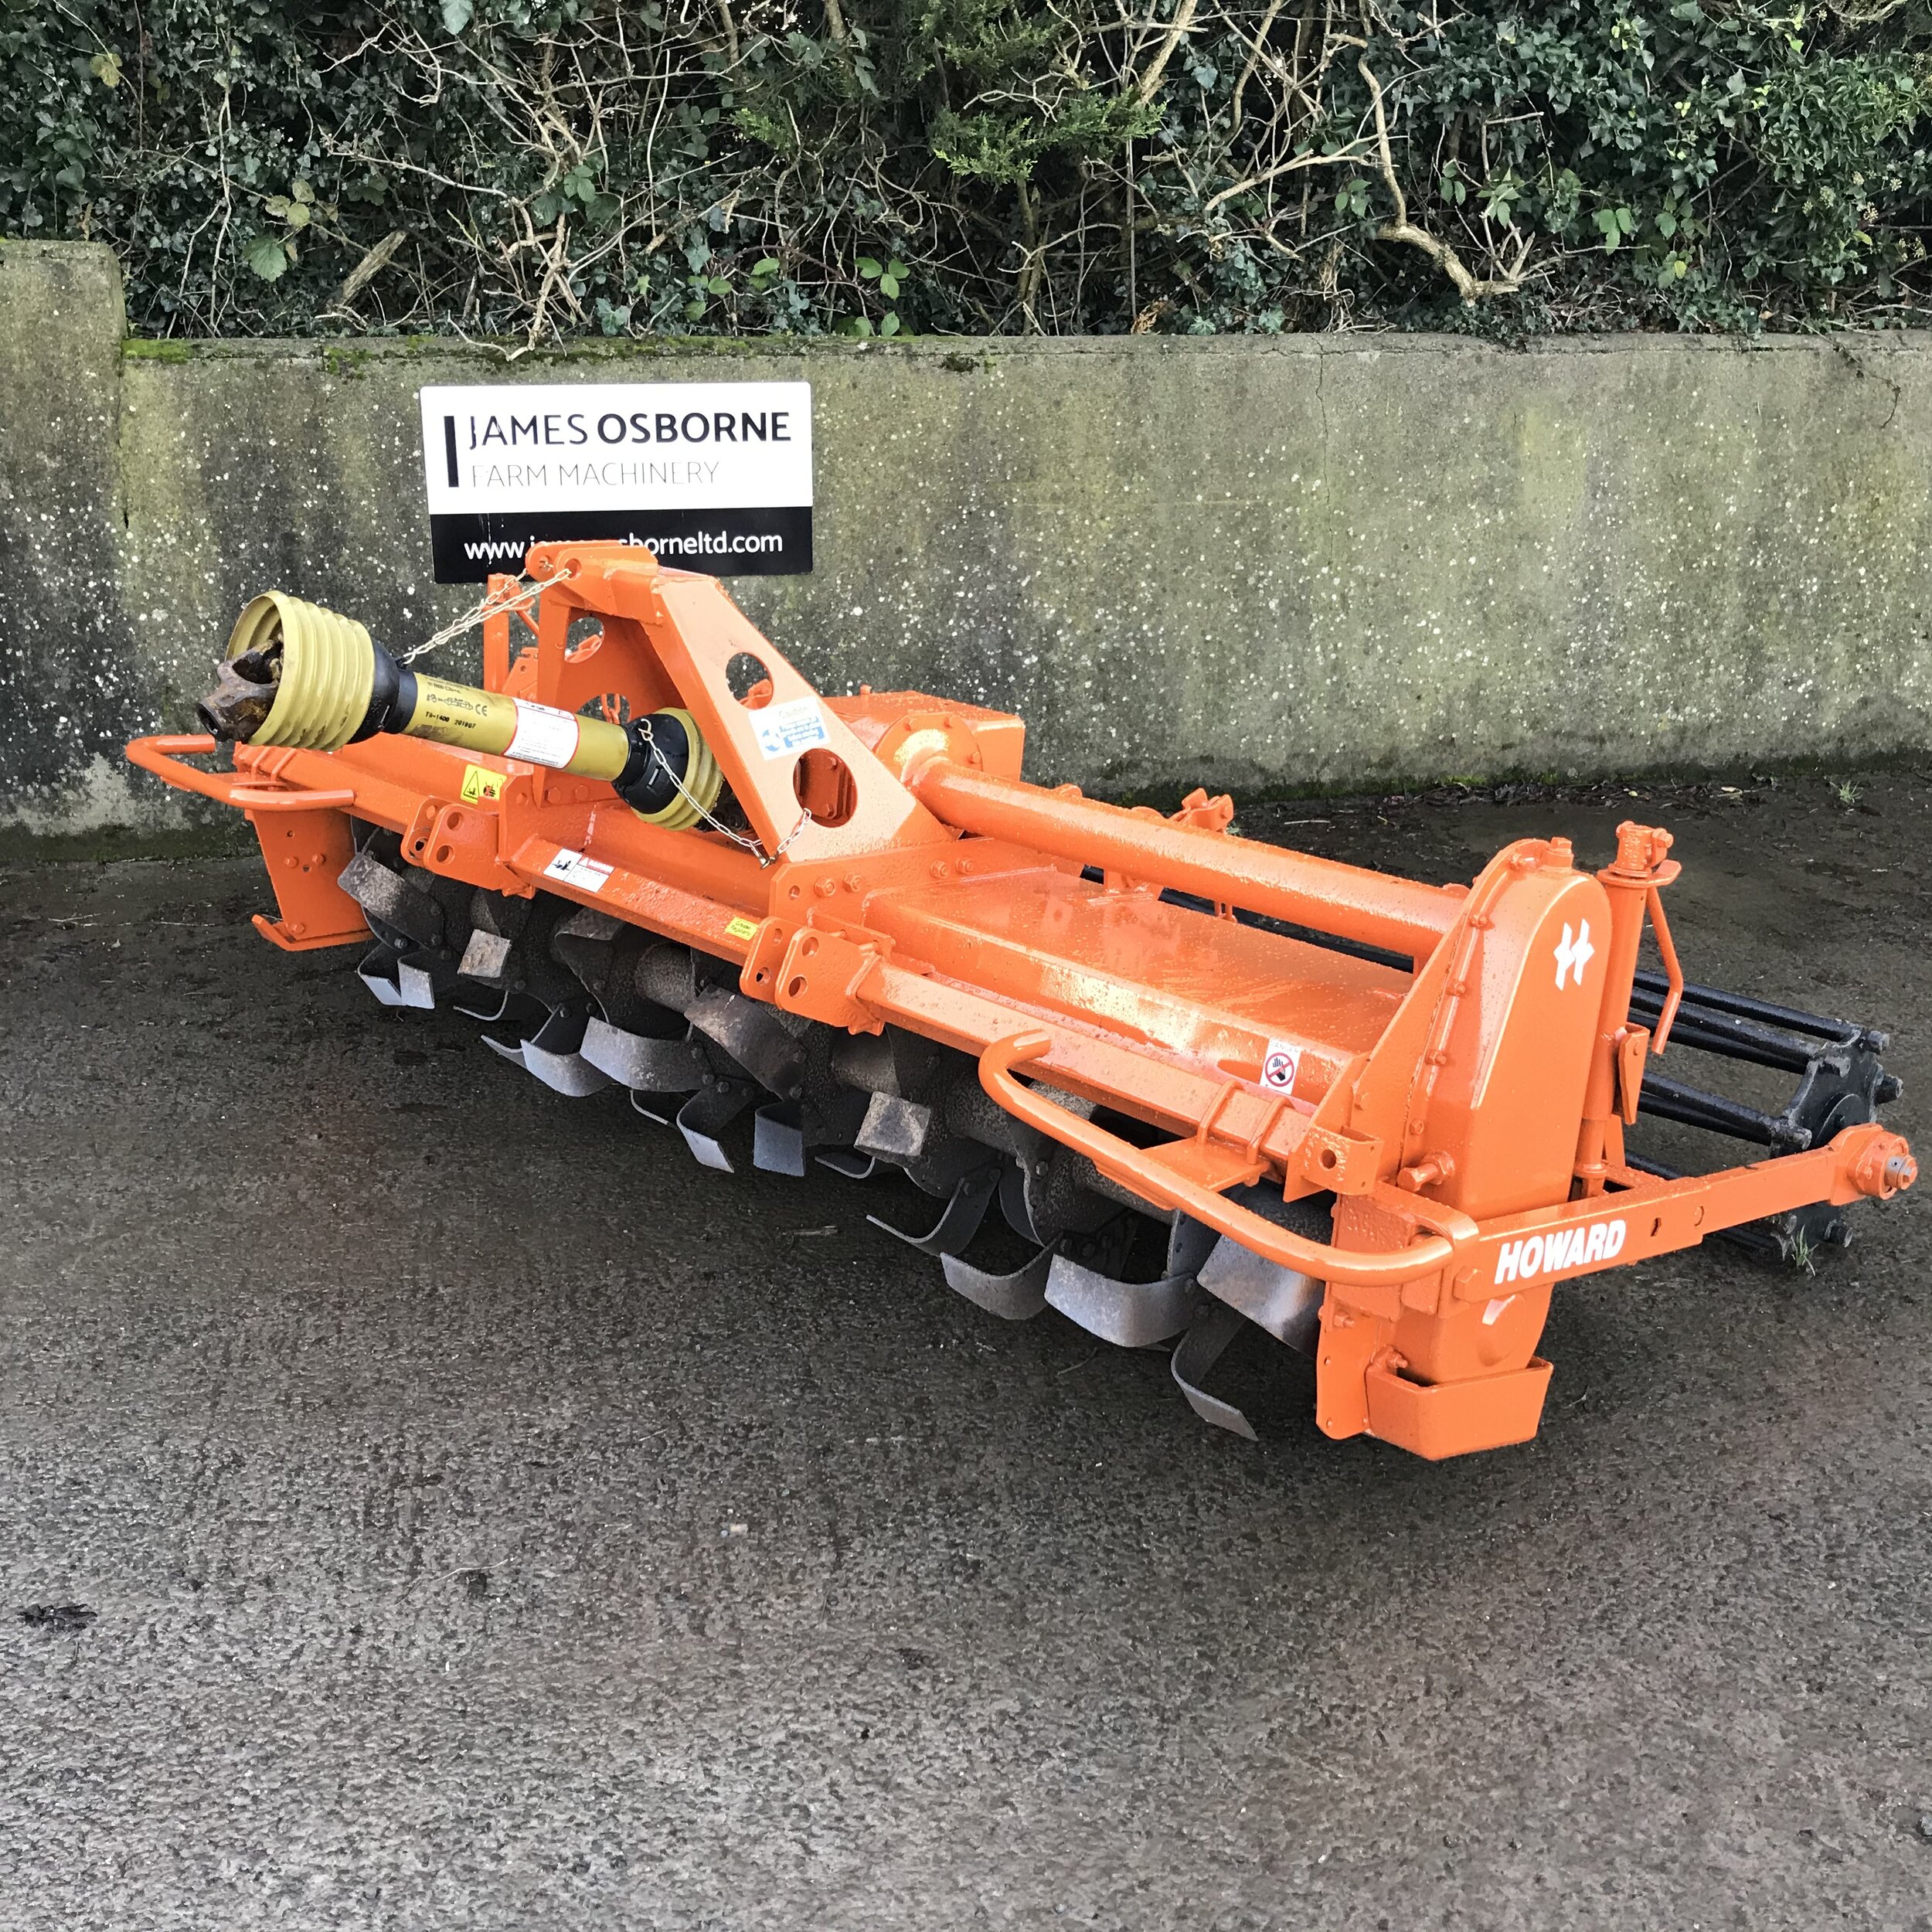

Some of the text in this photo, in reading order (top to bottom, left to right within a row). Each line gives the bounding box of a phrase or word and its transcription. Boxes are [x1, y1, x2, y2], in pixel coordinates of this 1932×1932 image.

[469, 412, 791, 450] JAMES OSBORNE
[471, 461, 719, 488] FARM MACHINERY
[1494, 1219, 1628, 1284] HOWARD
